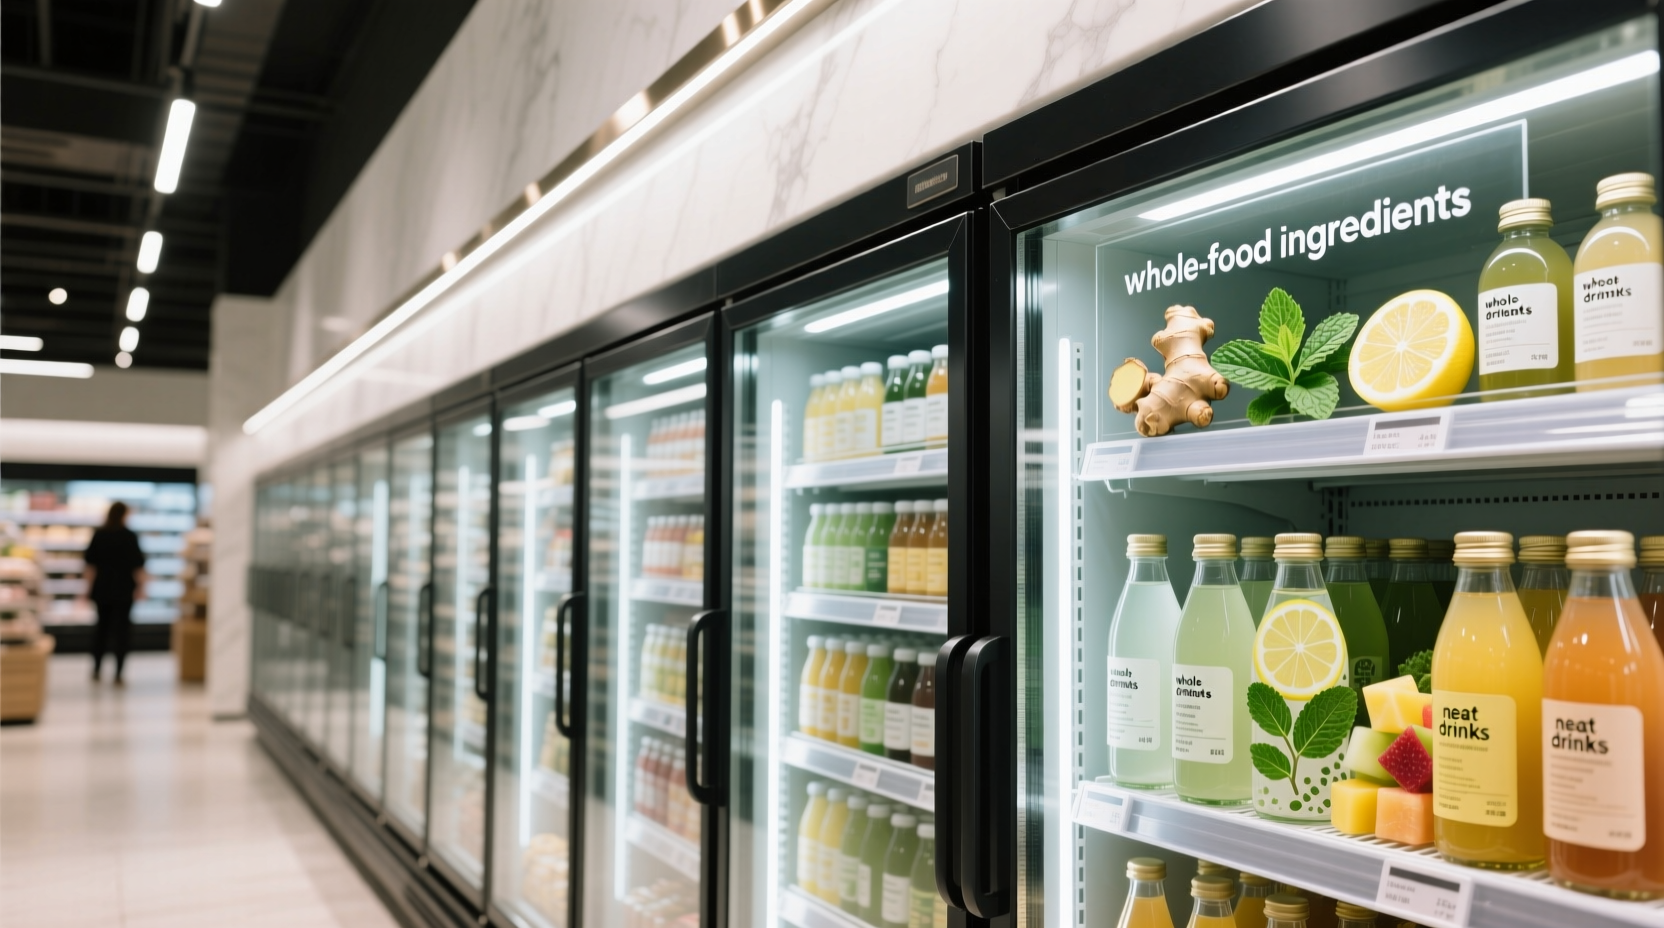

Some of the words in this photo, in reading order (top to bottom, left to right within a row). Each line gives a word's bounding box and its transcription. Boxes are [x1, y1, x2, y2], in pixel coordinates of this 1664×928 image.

[1124, 228, 1272, 295] whole-food
[1280, 185, 1472, 261] ingredients
[1442, 706, 1479, 722] neat
[1439, 720, 1490, 741] drinks
[1555, 717, 1596, 735] neat
[1551, 733, 1610, 755] drinks
